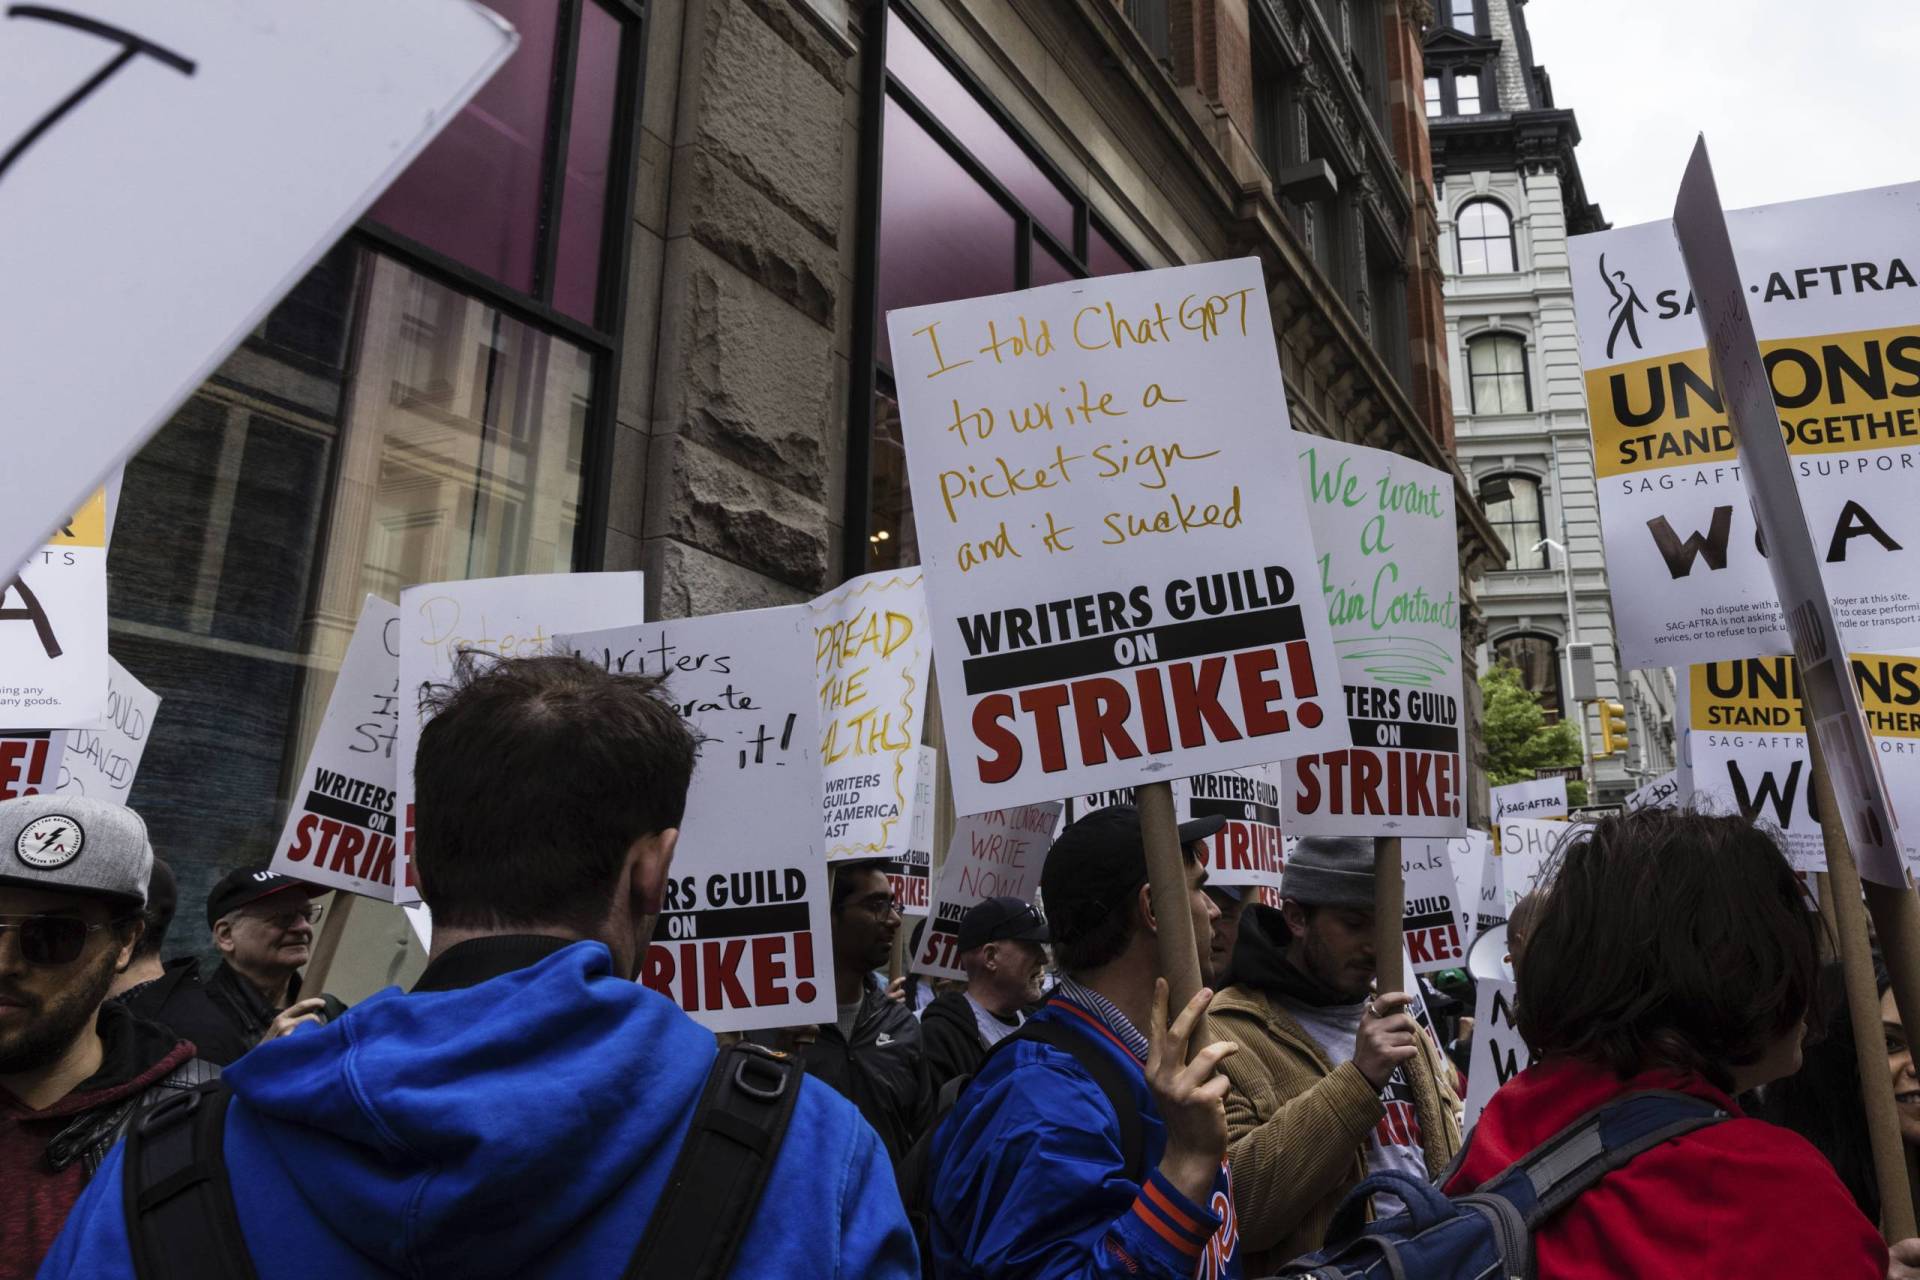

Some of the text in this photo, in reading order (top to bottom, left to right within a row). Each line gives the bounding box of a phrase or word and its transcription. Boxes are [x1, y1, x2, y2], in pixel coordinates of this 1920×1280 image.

[1656, 258, 1918, 320] S·AFTRA
[912, 288, 1255, 378] I told ChatGPT
[1610, 336, 1920, 428] UNONS
[948, 381, 1187, 446] to write a
[1619, 408, 1920, 465] STAND GETHE
[939, 446, 1085, 523] picket
[1299, 447, 1445, 518] We want
[1622, 453, 1920, 496] SAG-AFT SUPPOR
[957, 486, 1242, 573] and it sucked
[1646, 499, 1903, 580] WA
[957, 565, 1295, 656] WRITERS GUILD
[1370, 562, 1458, 631] Contract
[1665, 617, 1719, 631] SAG-AFTRA
[1730, 615, 1746, 625] not
[1748, 612, 1778, 624] asking
[1840, 609, 1850, 617] to
[1852, 608, 1878, 616] cease
[1880, 602, 1920, 616] performi
[1700, 607, 1715, 616] No
[1716, 604, 1750, 616] dispute
[1751, 600, 1772, 611] with
[1832, 597, 1858, 608] loyer
[1871, 594, 1889, 604] this
[815, 607, 912, 674] PREAD
[1113, 633, 1159, 666] ON
[1654, 633, 1692, 645] services,
[1693, 632, 1703, 640] or
[1705, 630, 1716, 639] to
[1717, 627, 1745, 637] refuse
[1747, 626, 1758, 634] to
[1760, 623, 1778, 635] pick
[1839, 619, 1858, 628] ndle
[1872, 615, 1916, 626] transport
[671, 685, 761, 717] erate
[1706, 657, 1920, 706] UNINS
[24, 697, 62, 707] goods.
[108, 678, 144, 740] OULD
[971, 640, 1324, 784] STRIKE!
[1344, 685, 1457, 725] TERS GUILD
[1708, 706, 1790, 726] STAND
[821, 706, 902, 766] ALTH
[1376, 724, 1401, 746] ON
[1709, 735, 1804, 750] SAG-AFTR
[67, 730, 133, 789] DAVID
[314, 767, 397, 812] WRITERS
[823, 792, 860, 810] GUILD
[825, 774, 881, 794] WRITERS
[1190, 774, 1279, 808] WRITERS GUILD
[1296, 749, 1461, 818] STRIKE!
[368, 813, 388, 831] ON
[825, 824, 849, 838] AST
[834, 804, 899, 823] AMERICA
[1244, 803, 1257, 820] ON
[287, 814, 396, 887] STRIK
[911, 850, 930, 865] GUILD
[972, 831, 1031, 868] WRITE
[706, 868, 807, 908] GUILD
[888, 875, 930, 907] TRIKE!
[958, 866, 1024, 899] NOW!
[1406, 895, 1450, 916] GUILD
[668, 915, 697, 939] ON
[642, 931, 817, 1012] RIKE!
